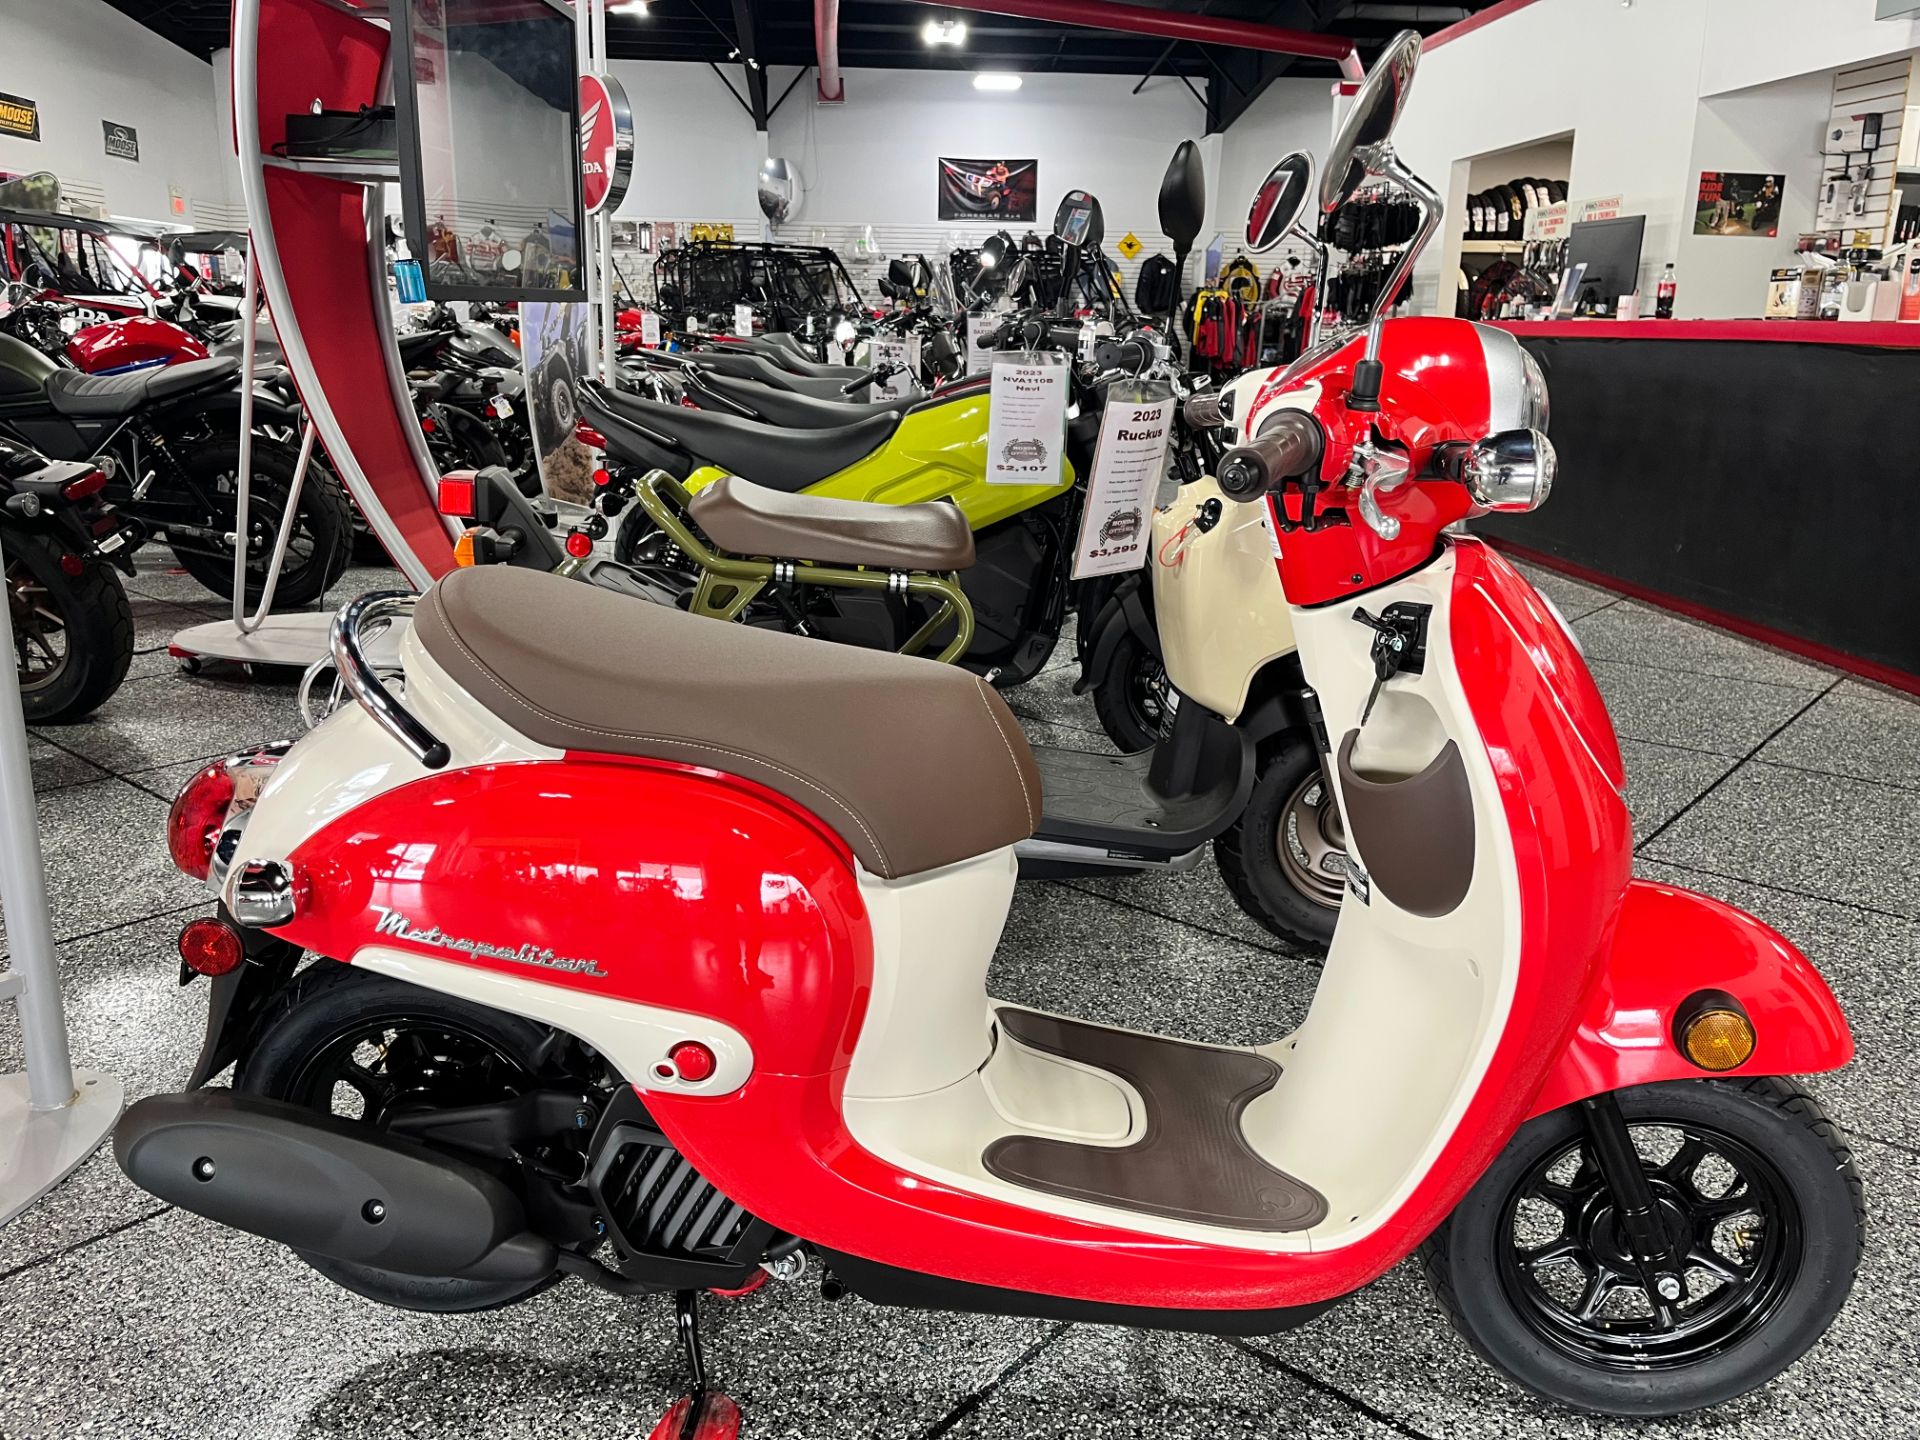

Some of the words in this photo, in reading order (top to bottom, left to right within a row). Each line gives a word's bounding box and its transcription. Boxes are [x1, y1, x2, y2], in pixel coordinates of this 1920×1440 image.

[0, 104, 33, 125] MOOSE
[108, 137, 135, 152] MOOSE
[1700, 182, 1723, 192] RIDE
[1699, 192, 1721, 201] FUN
[1132, 408, 1162, 422] 2023
[1117, 428, 1163, 441] Ruckus
[996, 464, 1048, 472] $2,107
[1089, 543, 1138, 558] $3,299
[370, 904, 608, 977] Metropolitan
